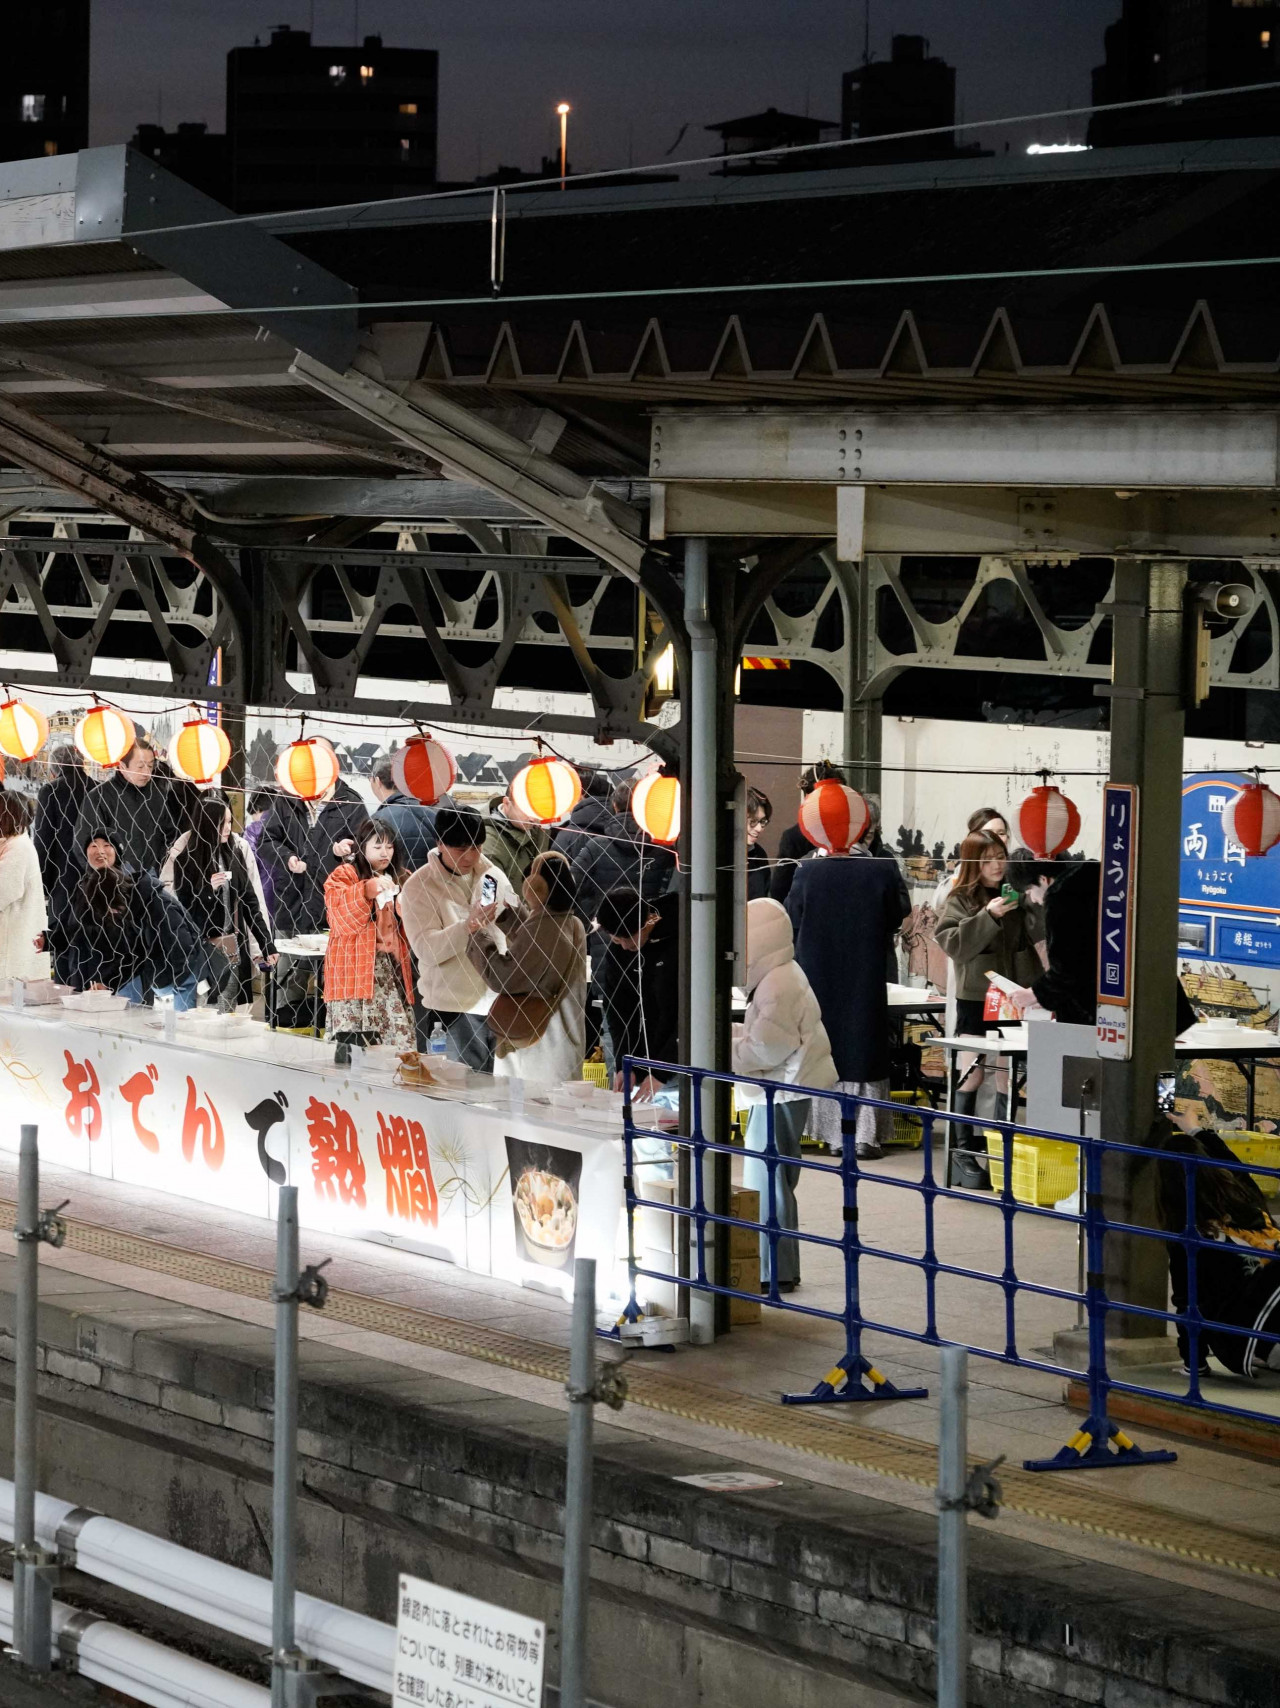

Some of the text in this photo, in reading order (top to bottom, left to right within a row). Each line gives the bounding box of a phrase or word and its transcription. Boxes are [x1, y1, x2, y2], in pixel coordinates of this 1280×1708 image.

[1106, 803, 1126, 953] りょうごく
[1197, 868, 1234, 884] りょうごく
[1097, 1026, 1126, 1044] リコー
[62, 1048, 439, 1231] おでんで熱燗
[401, 1595, 540, 1665] 線路内に落とされたお荷物等
